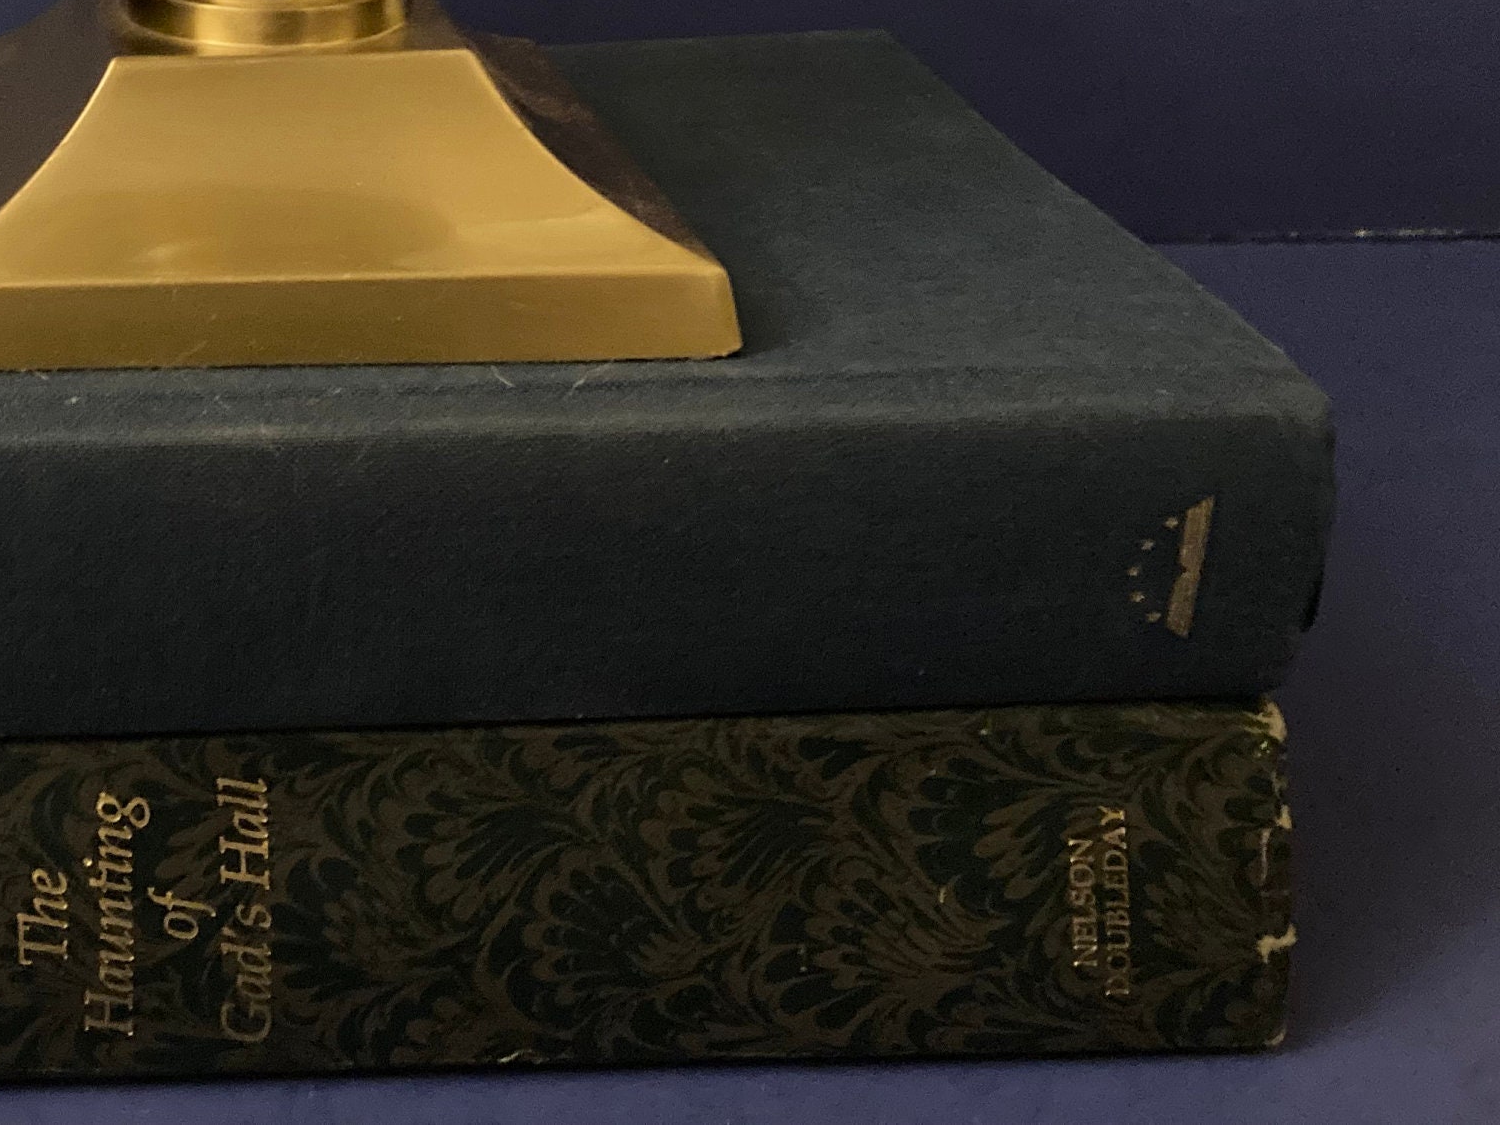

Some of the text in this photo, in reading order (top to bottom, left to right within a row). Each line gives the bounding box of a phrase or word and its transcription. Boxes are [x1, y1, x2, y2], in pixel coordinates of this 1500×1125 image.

[16, 866, 69, 966] The
[83, 791, 151, 1037] Haunting
[147, 886, 217, 941] of
[216, 776, 273, 1043] Gad's Hall
[1067, 838, 1099, 968] NELSON
[1098, 805, 1131, 997] DOUBLEDAY
